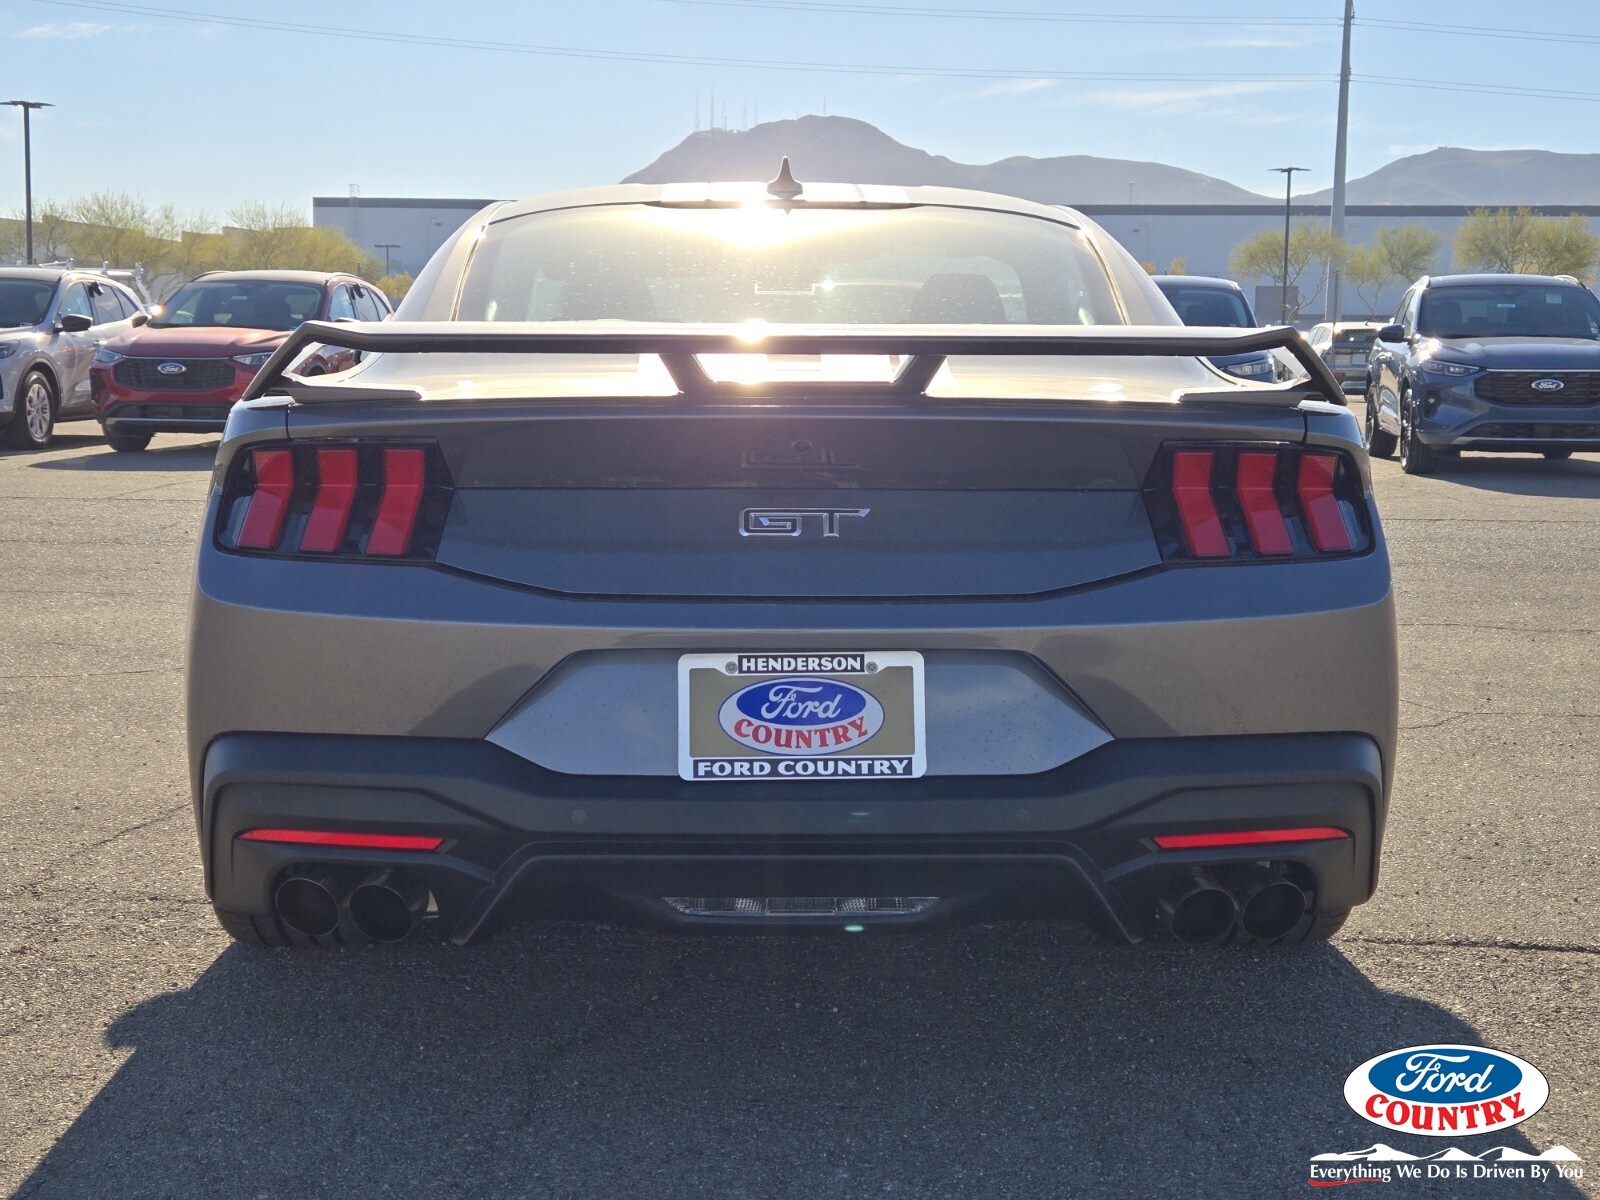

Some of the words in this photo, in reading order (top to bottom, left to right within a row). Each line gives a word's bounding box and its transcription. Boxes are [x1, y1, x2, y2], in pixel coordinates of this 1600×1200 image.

[739, 508, 870, 538] GT
[742, 656, 861, 672] HENDERSON
[760, 685, 842, 719] Ford
[734, 716, 868, 749] COUNTRY
[698, 761, 771, 776] FORD
[777, 759, 909, 776] COUNTRY
